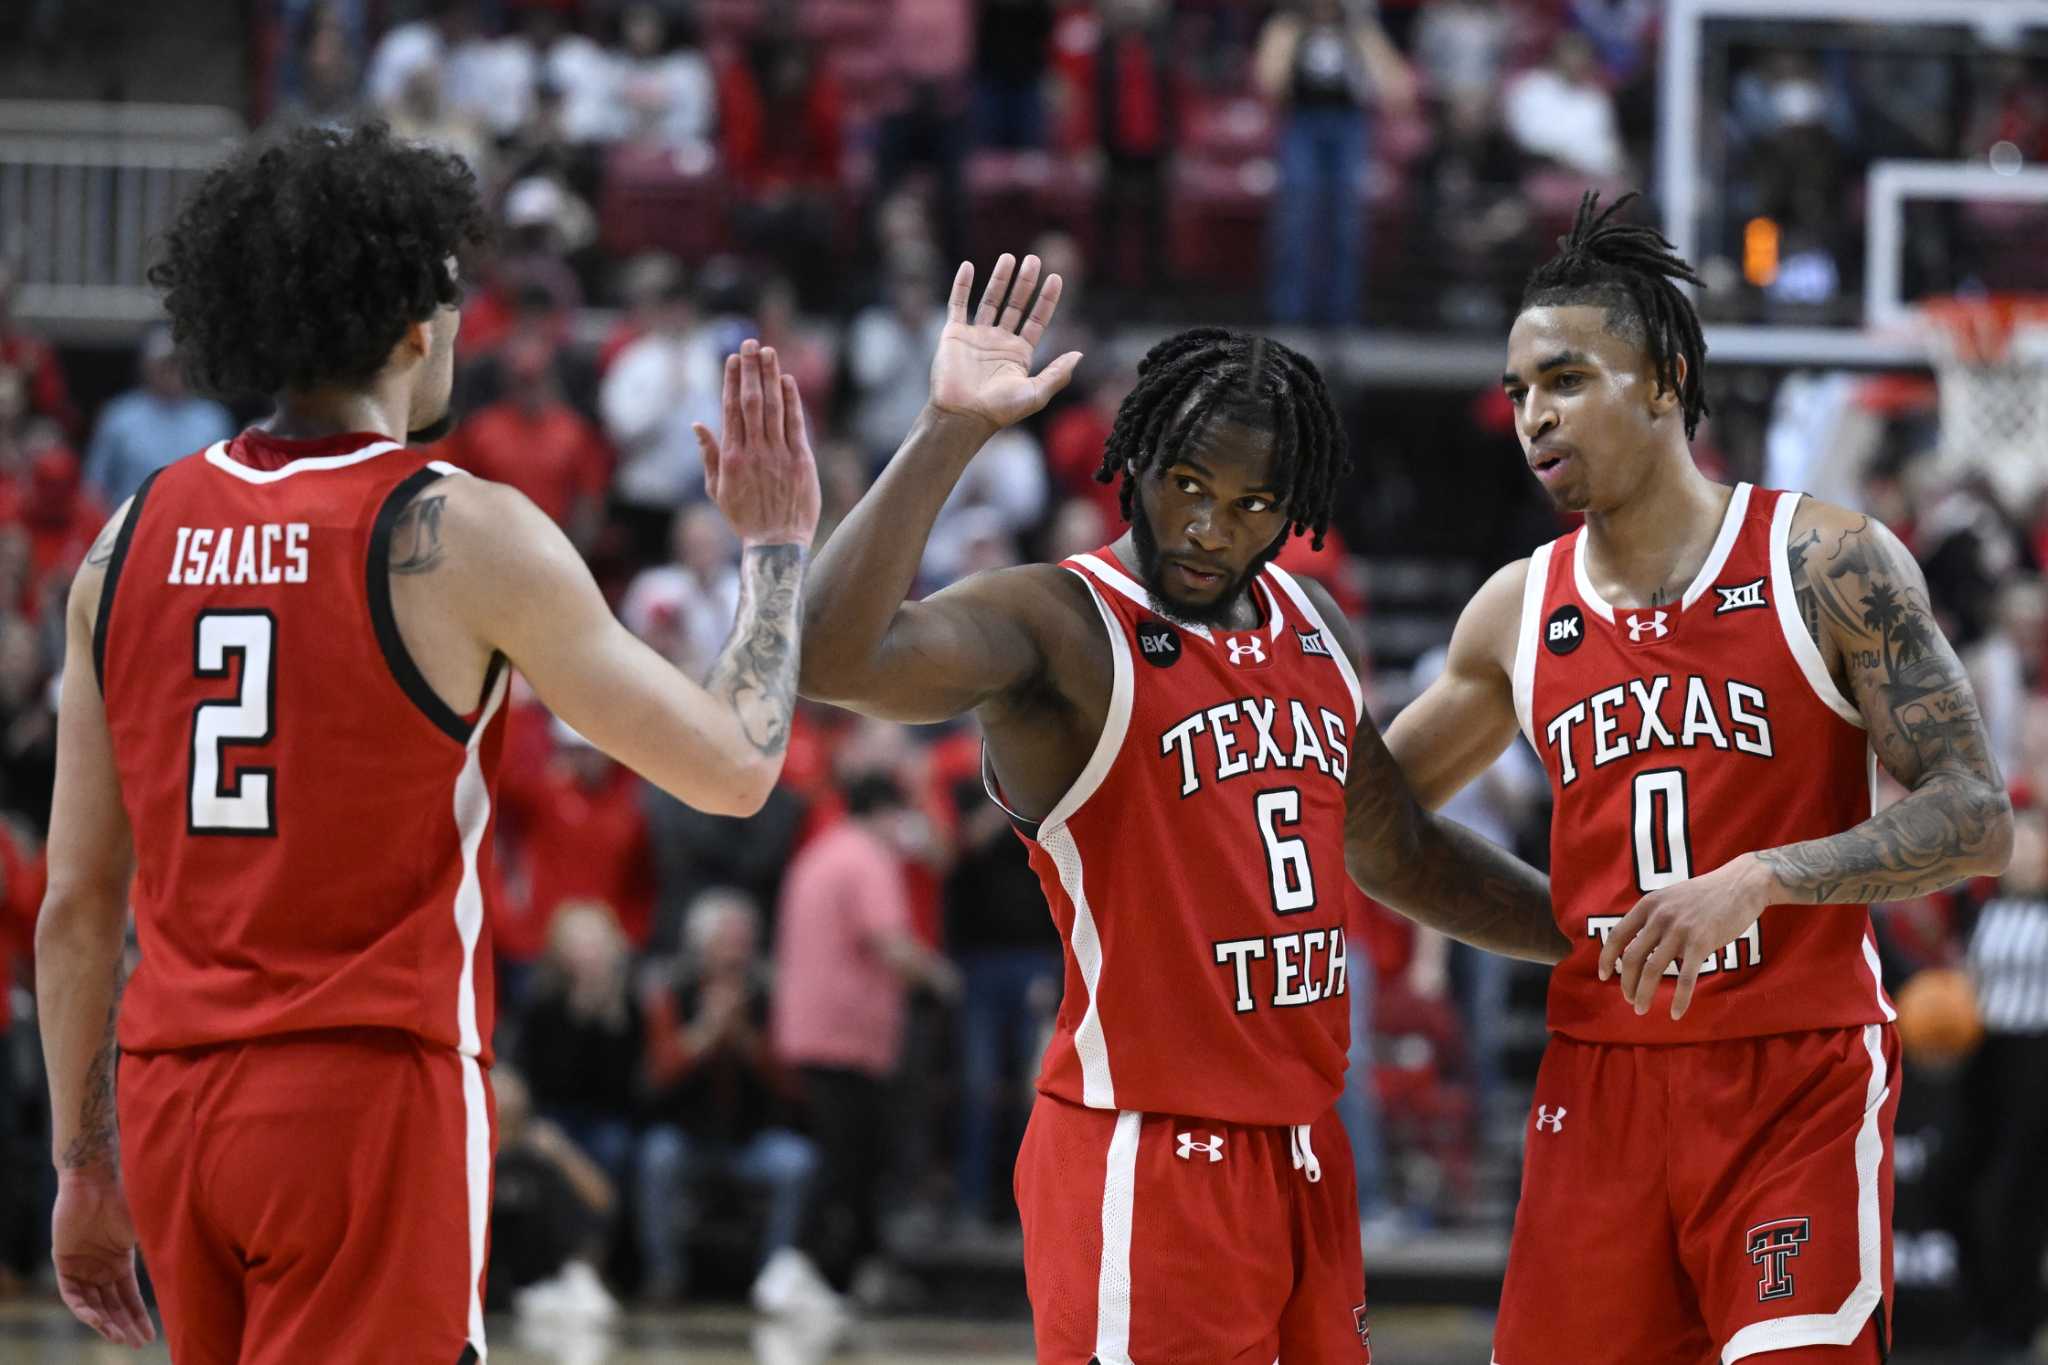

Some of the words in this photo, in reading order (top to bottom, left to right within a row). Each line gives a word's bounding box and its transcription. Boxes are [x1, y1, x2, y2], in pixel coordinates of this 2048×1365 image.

[168, 523, 310, 585] ISAACS
[1140, 632, 1176, 655] BK
[1548, 616, 1580, 642] BK
[187, 608, 278, 836] 2
[1160, 697, 1349, 799] TEXAS
[1545, 674, 1774, 788] TEXAS
[1254, 786, 1318, 916] 6
[1630, 766, 1693, 895] 0
[1214, 927, 1347, 1015] TECH
[1587, 915, 1763, 978] TH
